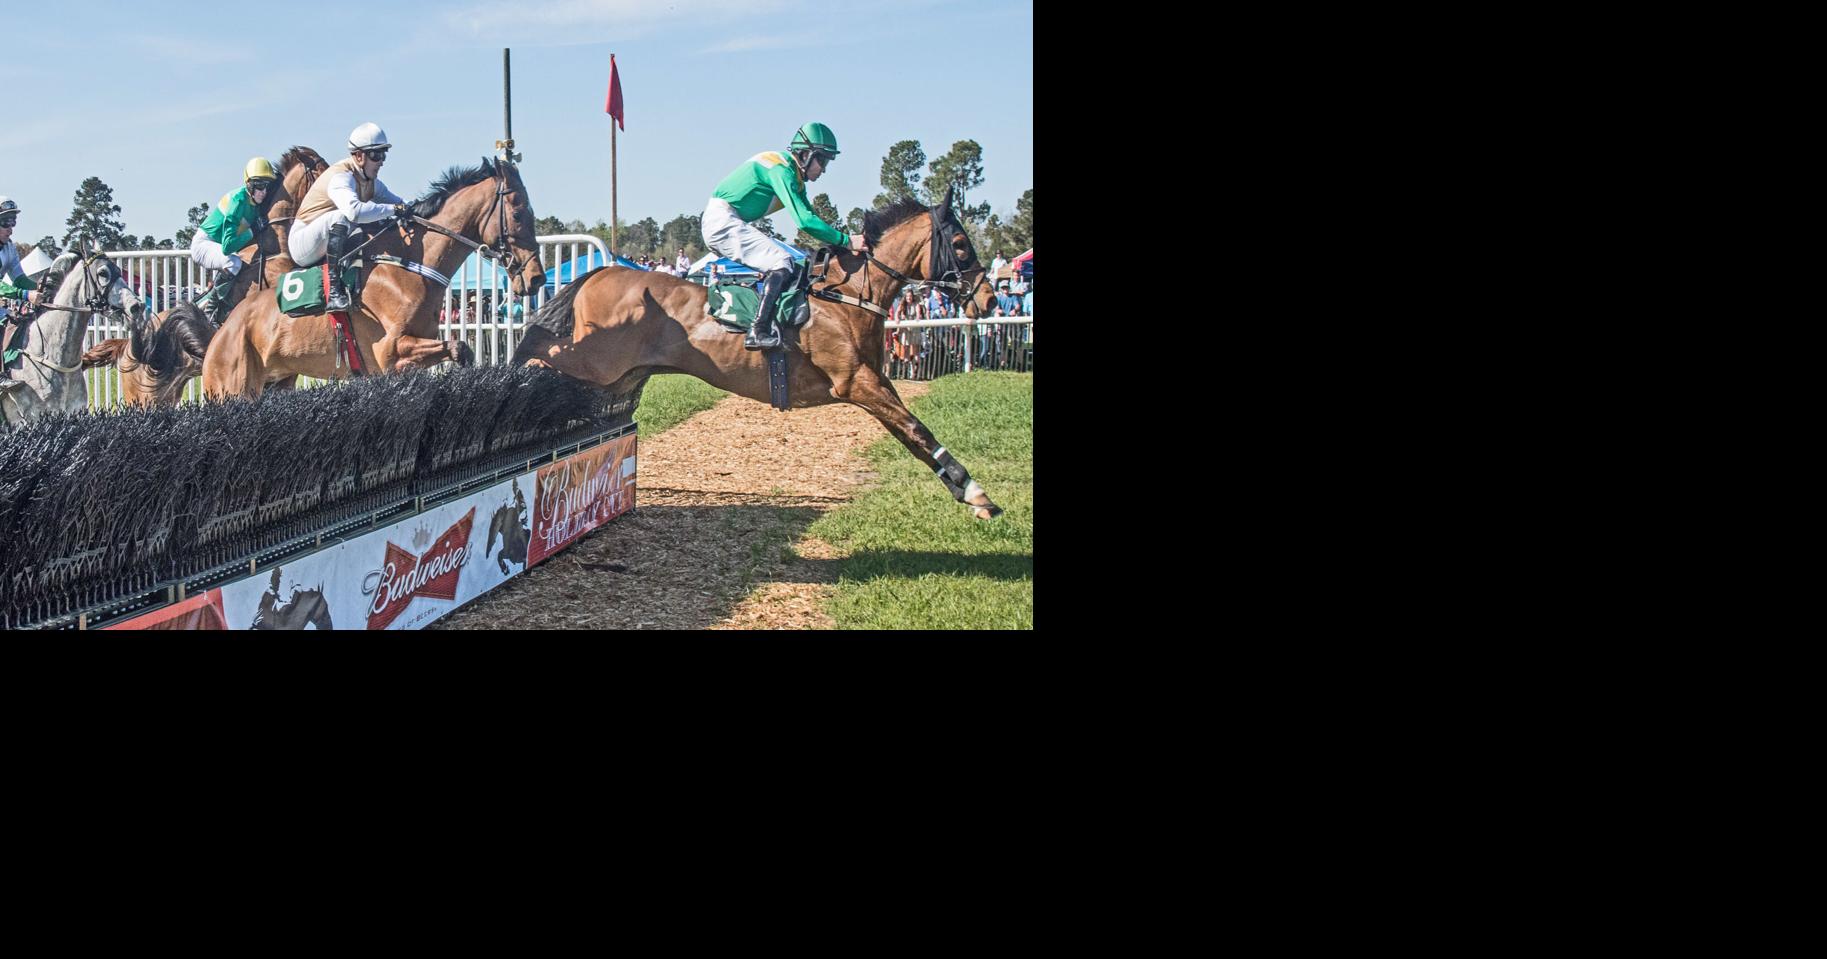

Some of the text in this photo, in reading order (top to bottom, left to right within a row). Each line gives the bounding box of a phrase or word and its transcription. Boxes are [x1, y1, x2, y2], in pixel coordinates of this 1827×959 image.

[282, 268, 308, 302] 6
[713, 289, 737, 322] 2
[361, 541, 473, 620] Budweiser
